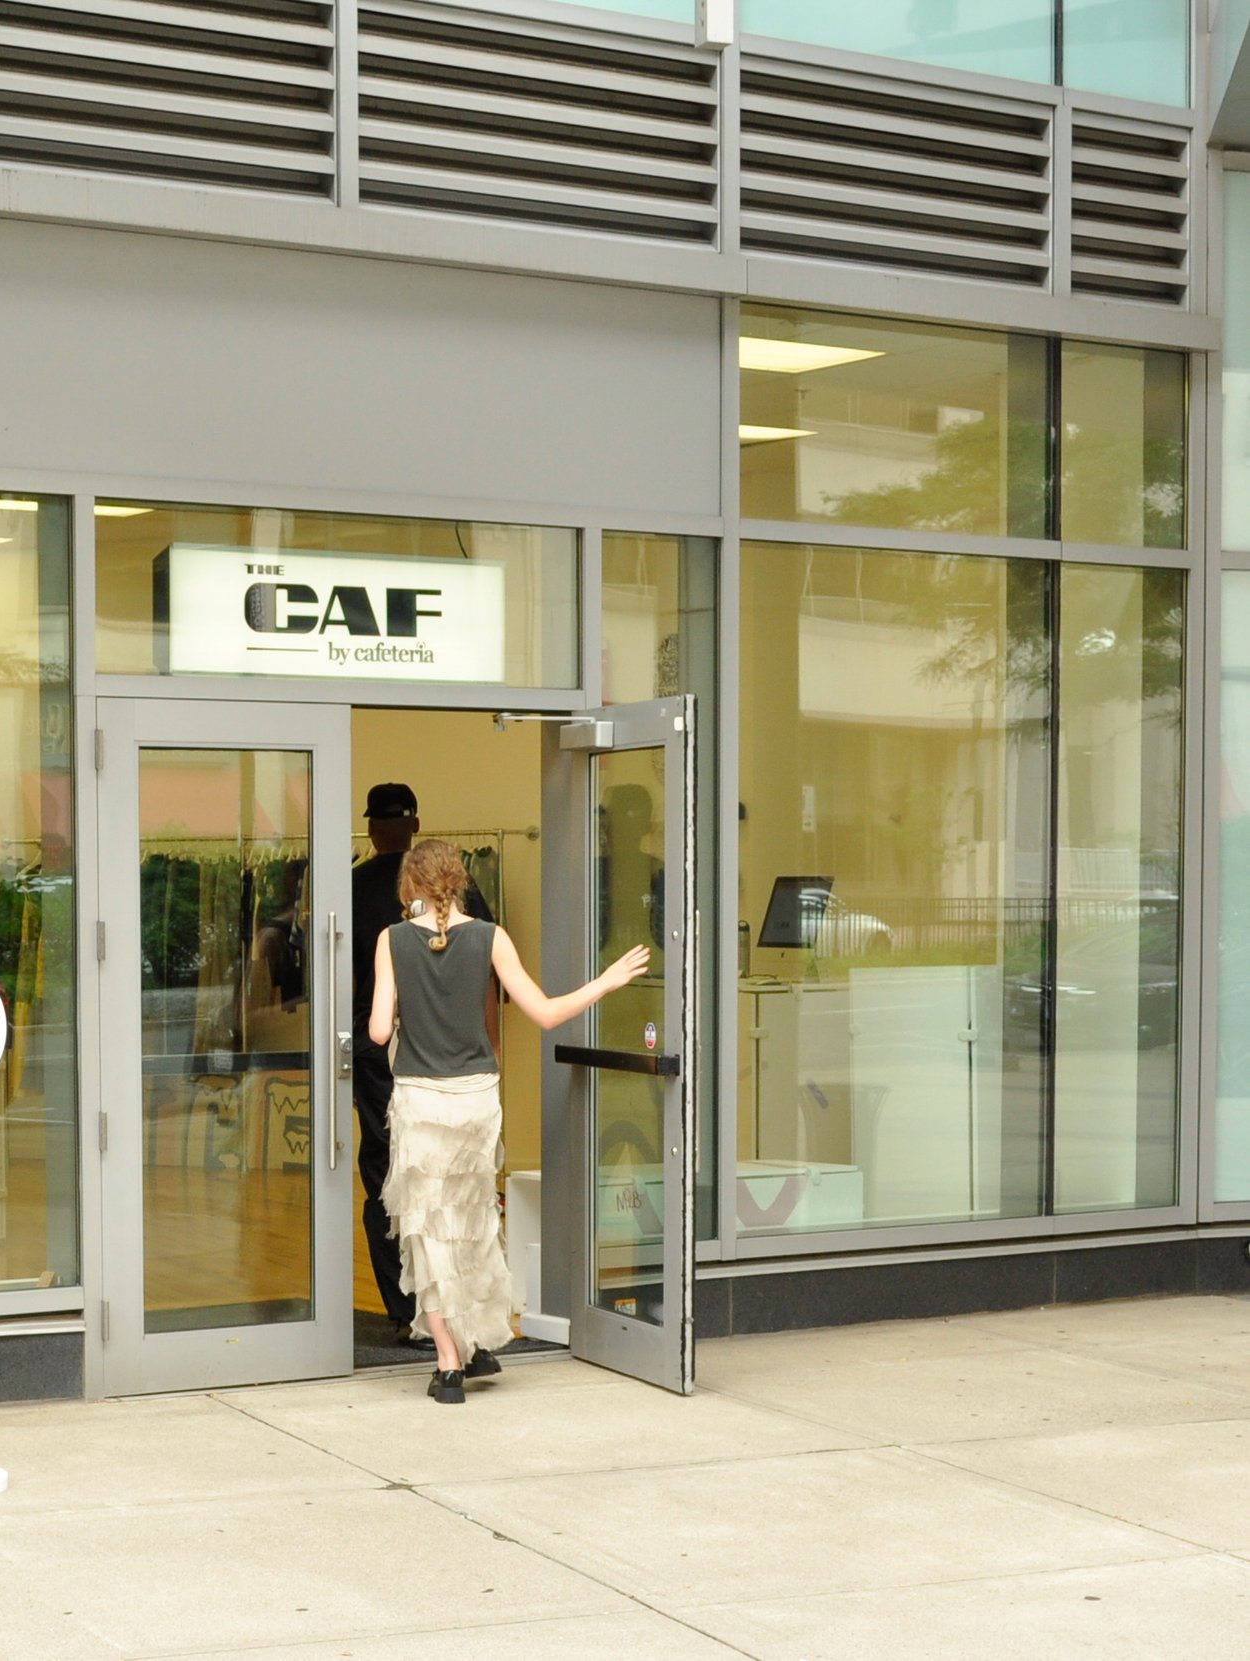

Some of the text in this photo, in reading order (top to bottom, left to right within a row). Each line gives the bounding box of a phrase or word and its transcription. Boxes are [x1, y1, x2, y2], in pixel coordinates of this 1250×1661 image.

[244, 563, 285, 576] THE
[244, 582, 442, 638] CAF
[328, 641, 435, 665] by cafeteria
